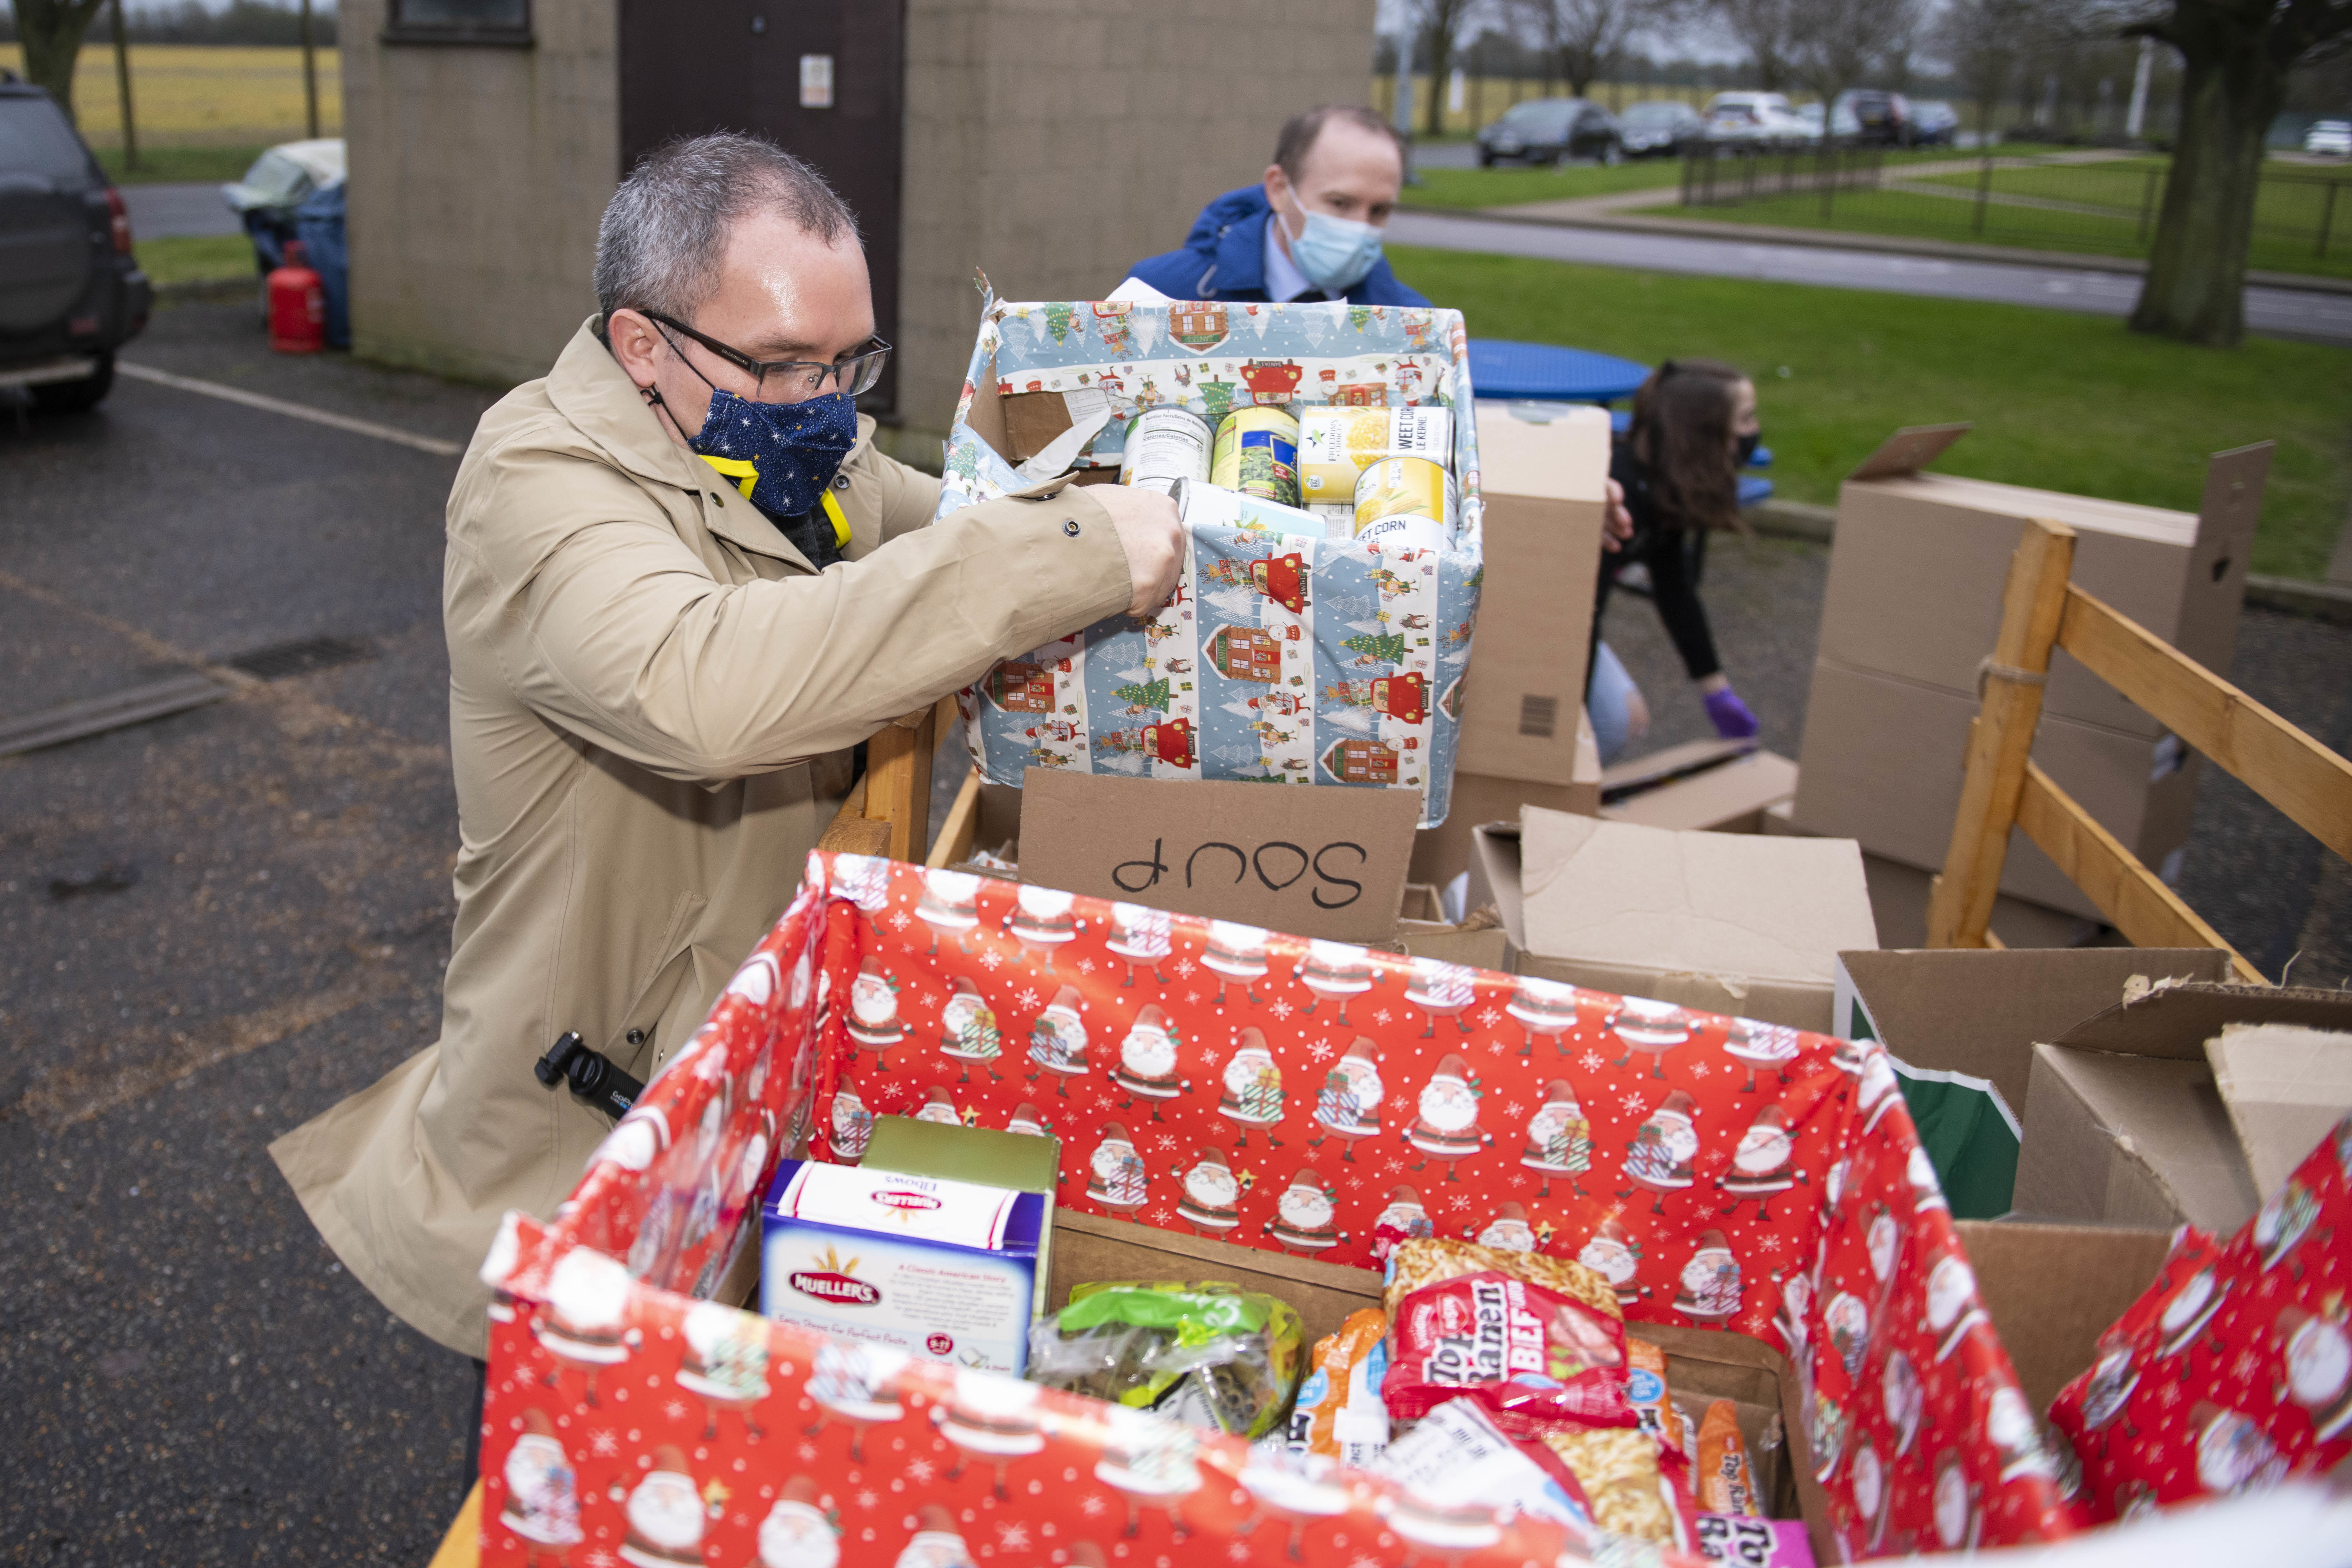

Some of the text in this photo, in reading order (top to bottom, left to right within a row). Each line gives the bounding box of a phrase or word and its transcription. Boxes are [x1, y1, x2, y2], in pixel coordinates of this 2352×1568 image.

[1398, 422, 1413, 450] WEET
[1416, 416, 1427, 440] KERNEL
[1375, 520, 1406, 535] CORN
[1112, 838, 1367, 909] SOUP
[940, 1269, 980, 1280] American
[795, 1274, 874, 1304] MUELLER'S
[1722, 1455, 1740, 1480] Top
[1735, 1522, 1771, 1564] To
